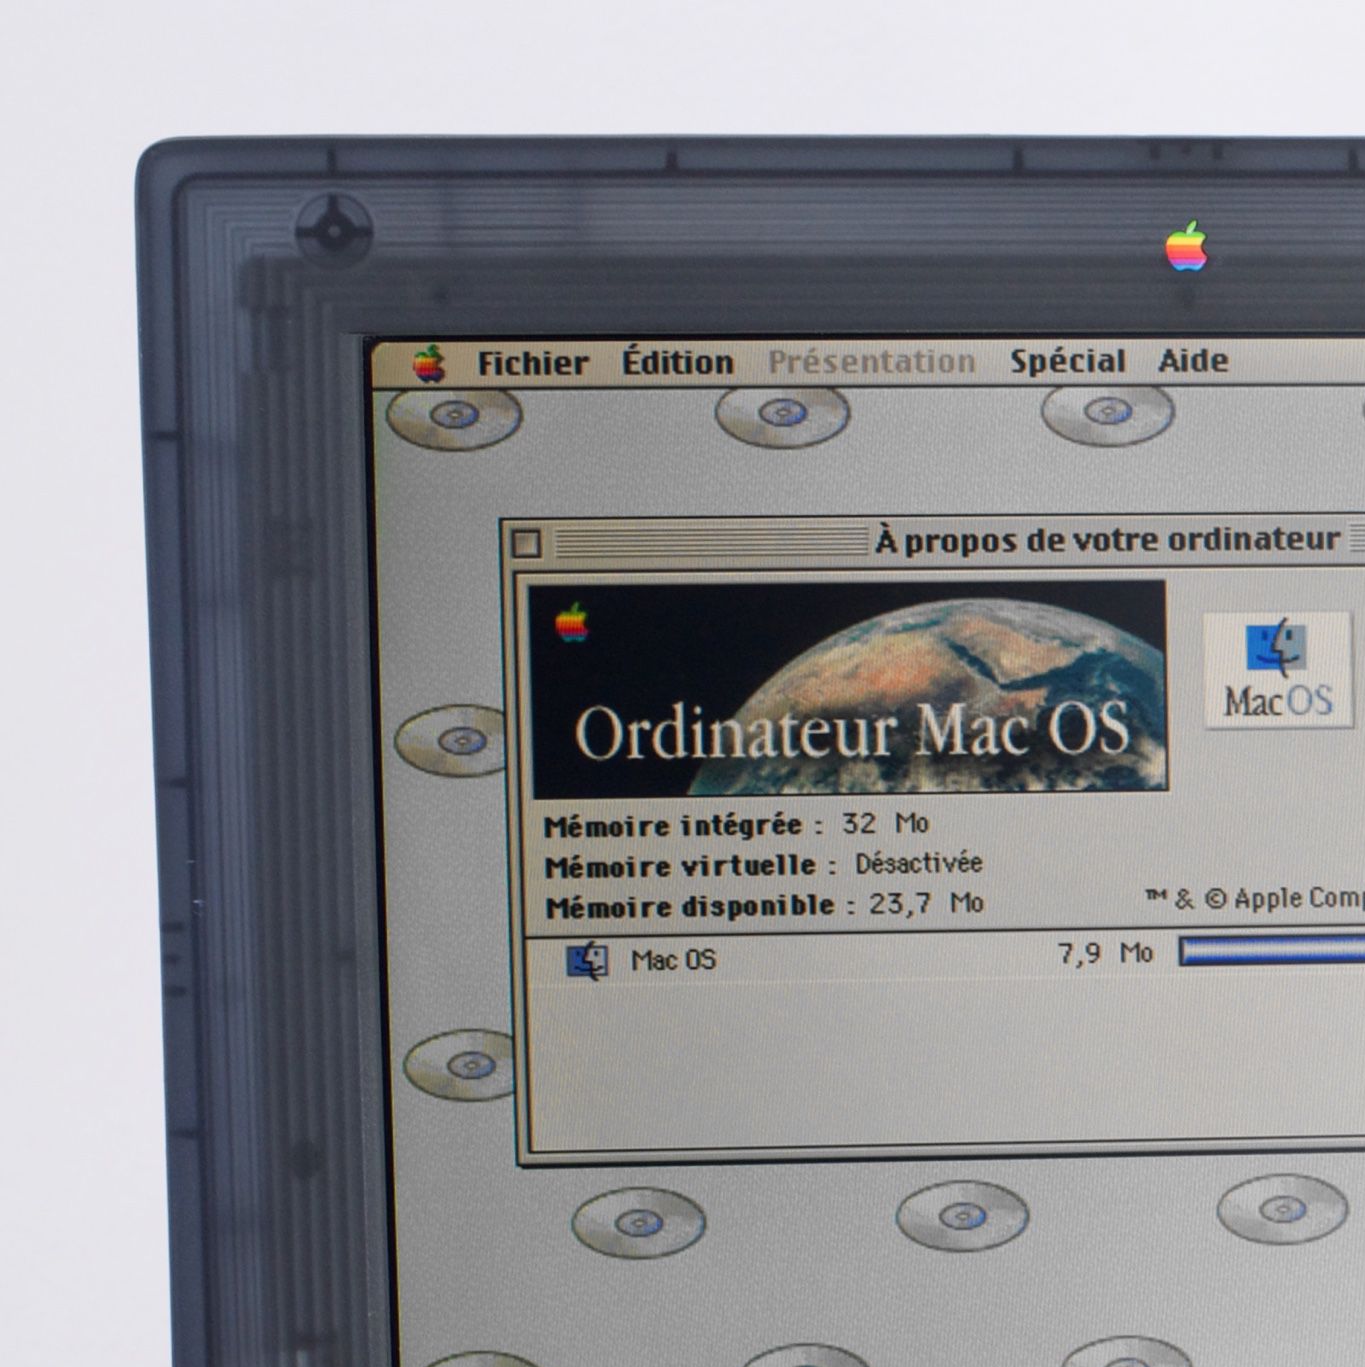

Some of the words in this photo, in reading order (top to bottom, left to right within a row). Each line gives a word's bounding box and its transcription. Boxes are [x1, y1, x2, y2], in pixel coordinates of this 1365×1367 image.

[478, 350, 589, 377] Fichier
[622, 344, 734, 376] Édition
[767, 349, 976, 376] Présentation
[1010, 347, 1126, 382] Spécial
[1158, 348, 1228, 374] Aide
[876, 522, 897, 554] À
[905, 530, 1017, 560] propos
[1027, 527, 1064, 553] de
[1072, 531, 1159, 553] votre
[1169, 525, 1341, 551] ordinateur
[576, 703, 897, 761] Ordinateur
[917, 703, 1031, 756] Mac
[1048, 699, 1132, 755] OS
[544, 815, 670, 838] Mémoire
[842, 812, 877, 835] 32
[895, 813, 930, 834] Mo
[545, 855, 671, 878] Mémoire
[856, 851, 984, 876] Désactivée
[546, 895, 672, 919] Mémoire
[869, 893, 931, 918] 23,7
[950, 892, 984, 914] Mo
[1205, 887, 1228, 909] ©
[1234, 885, 1302, 914] Apple
[632, 948, 678, 972] Mac
[686, 948, 716, 970] OS
[1057, 942, 1101, 967] 7,9
[1119, 942, 1154, 963] Mo
